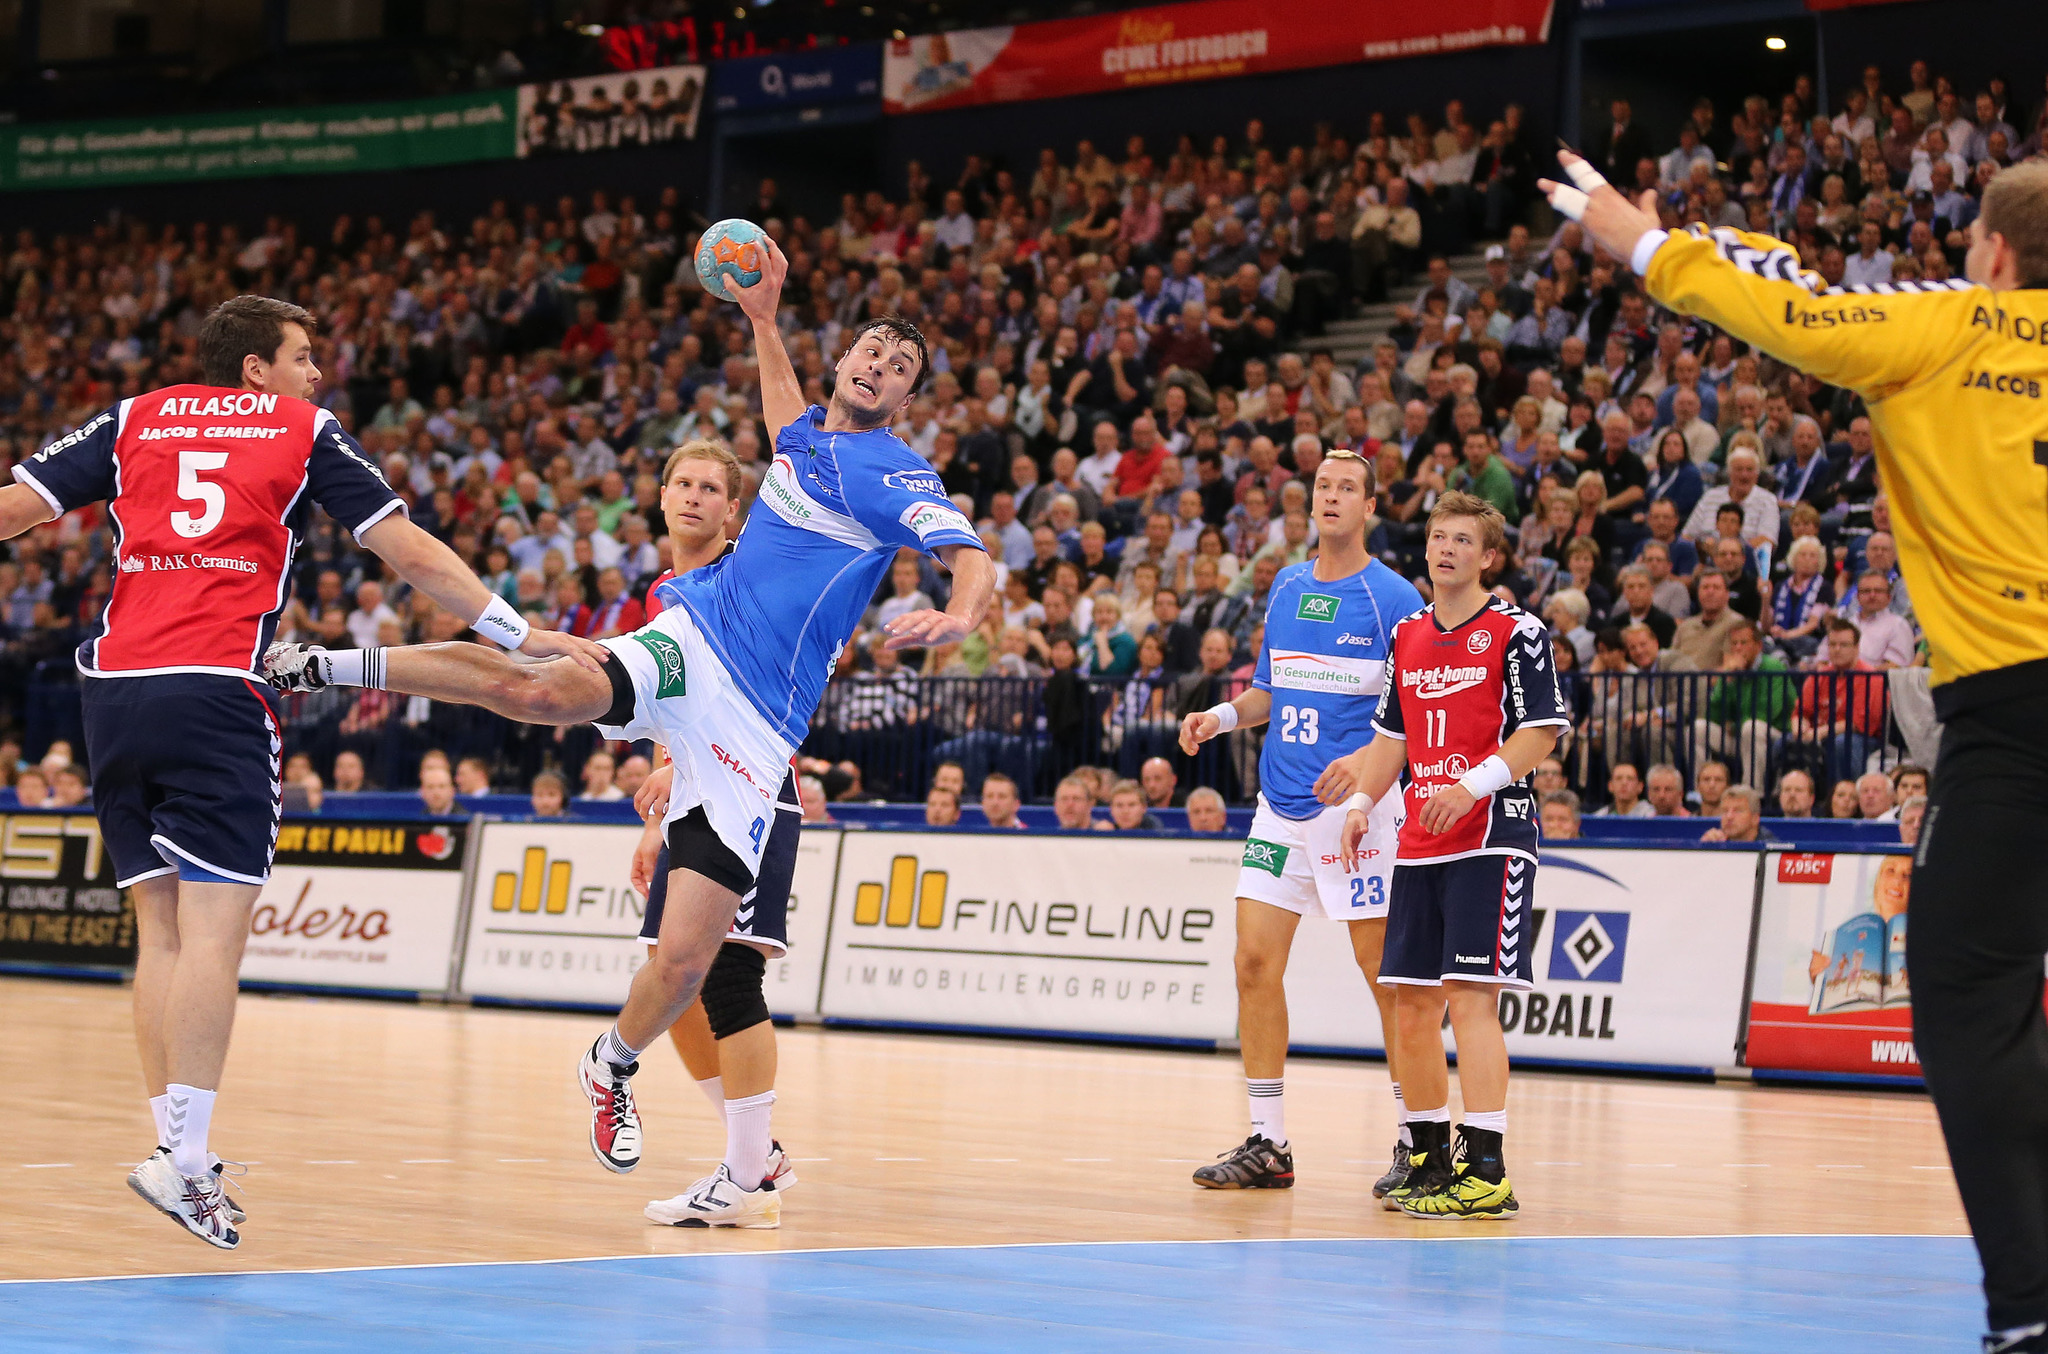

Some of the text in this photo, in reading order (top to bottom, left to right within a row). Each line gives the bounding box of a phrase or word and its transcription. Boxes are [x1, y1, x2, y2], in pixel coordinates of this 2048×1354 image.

[1161, 29, 1268, 66] FOTOBUCH
[1962, 371, 2041, 398] JACOB
[158, 393, 278, 416] ATLASON
[138, 426, 198, 440] JACOB
[170, 450, 230, 539] 5
[150, 553, 258, 573] RAK Ceramics
[1304, 598, 1332, 613] AOK
[646, 639, 682, 687] AOK
[1284, 666, 1361, 685] GesundHeits
[1402, 665, 1488, 688] bet-at-home
[1306, 681, 1360, 694] Deutschland
[1426, 683, 1446, 691] .com
[1281, 705, 1319, 745] 23
[1426, 709, 1447, 748] 11
[1413, 759, 1444, 779] Nord
[333, 827, 406, 855] PAULI
[749, 816, 766, 855] 4
[1245, 842, 1278, 864] AOK
[1321, 849, 1381, 865] SHRP
[8, 885, 69, 911] LOUNGE
[74, 887, 121, 913] HOTEL
[1350, 875, 1386, 908] 23
[251, 878, 391, 941] olero
[1455, 953, 1490, 966] hummel
[844, 965, 1206, 1006] IMMOBILIENGRUPPE
[1497, 991, 1616, 1040] DBALL
